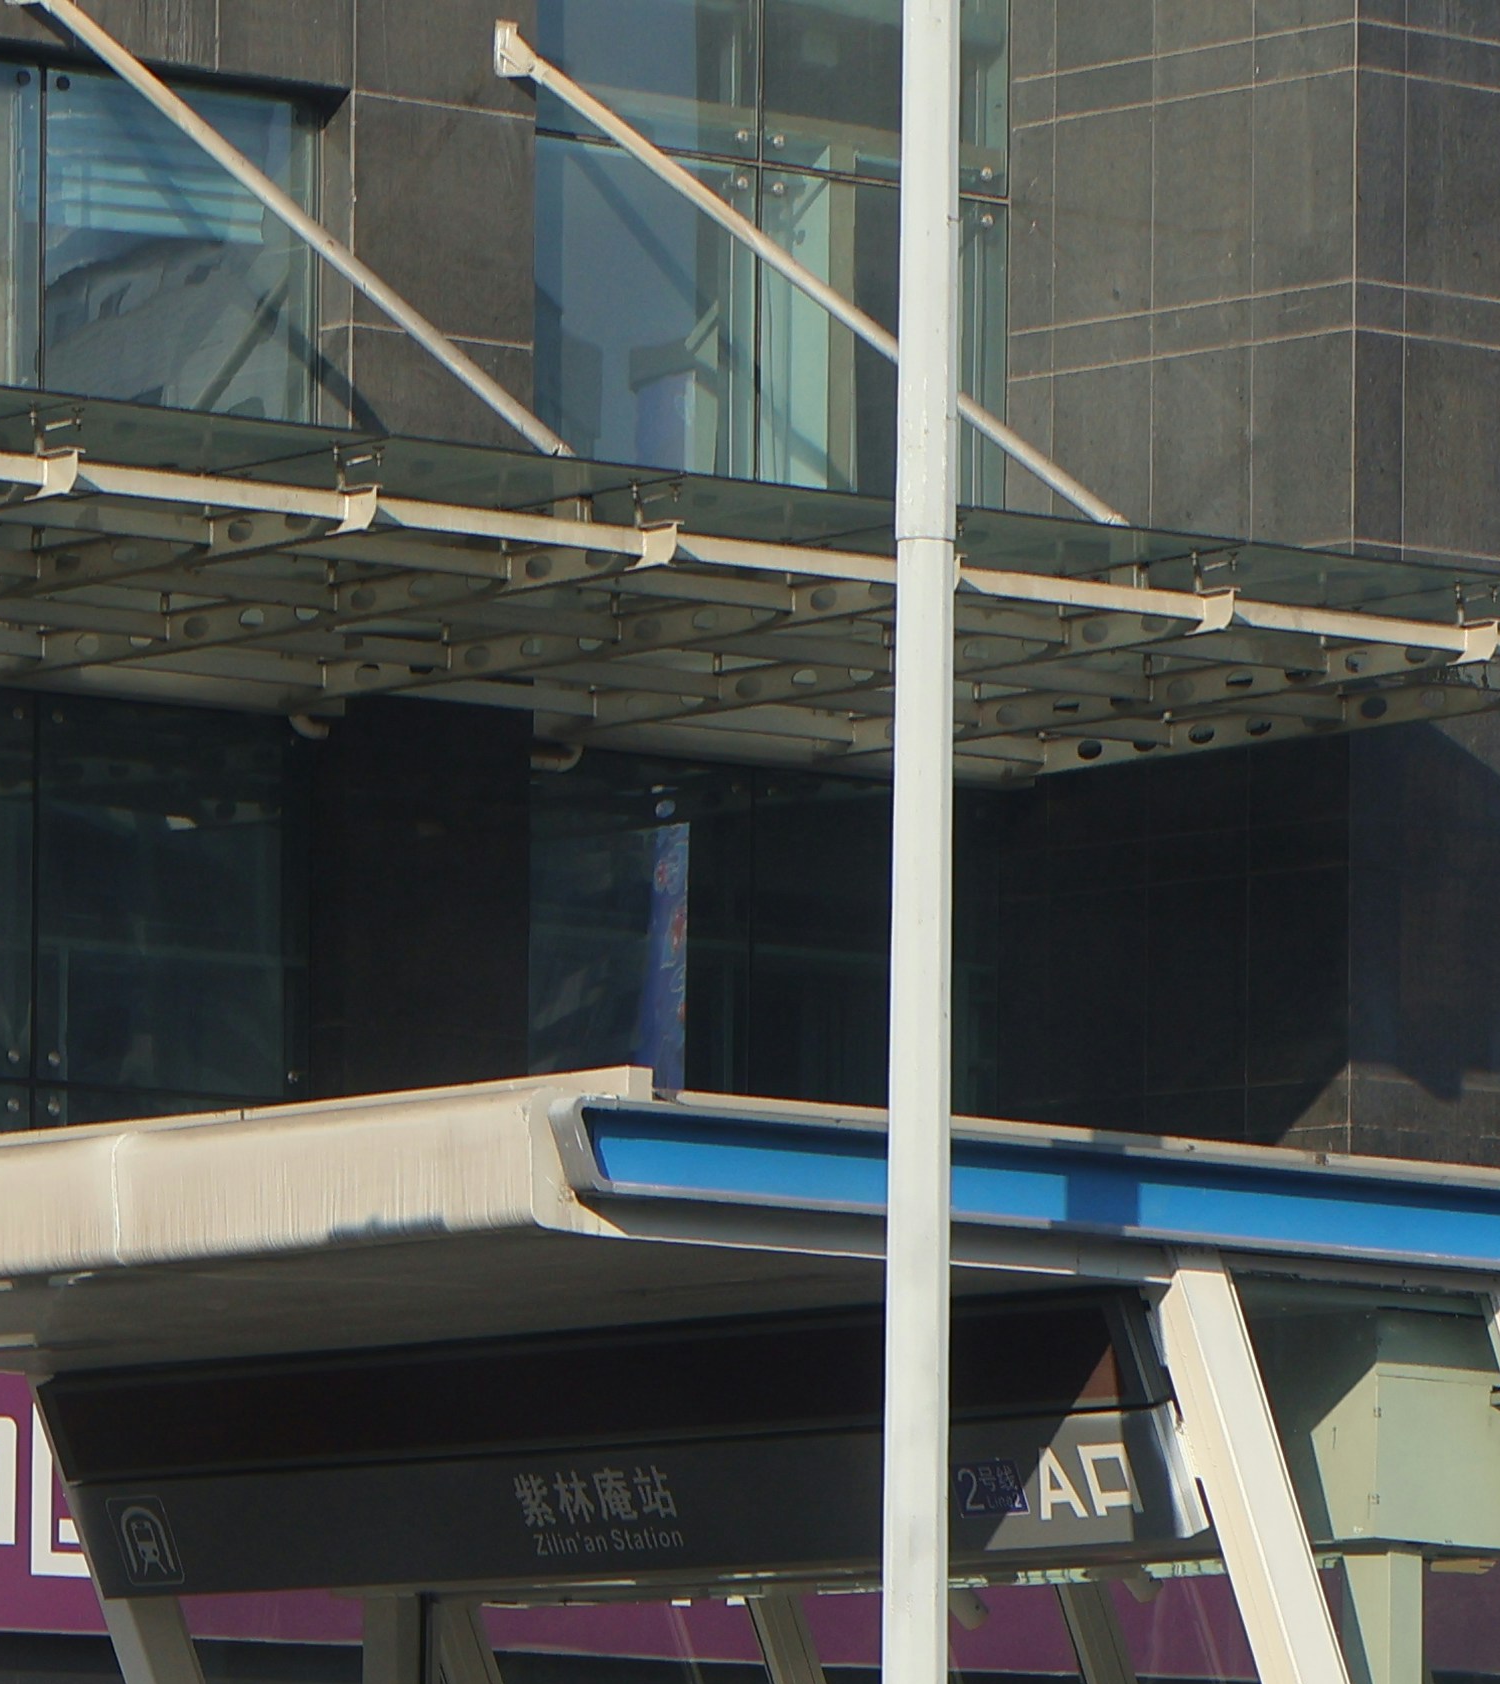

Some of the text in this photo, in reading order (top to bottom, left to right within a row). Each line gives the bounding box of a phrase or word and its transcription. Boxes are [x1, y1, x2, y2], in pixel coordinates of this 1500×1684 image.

[513, 1465, 678, 1527] 紫林庵站
[534, 1526, 684, 1556] Zilin'an Station
